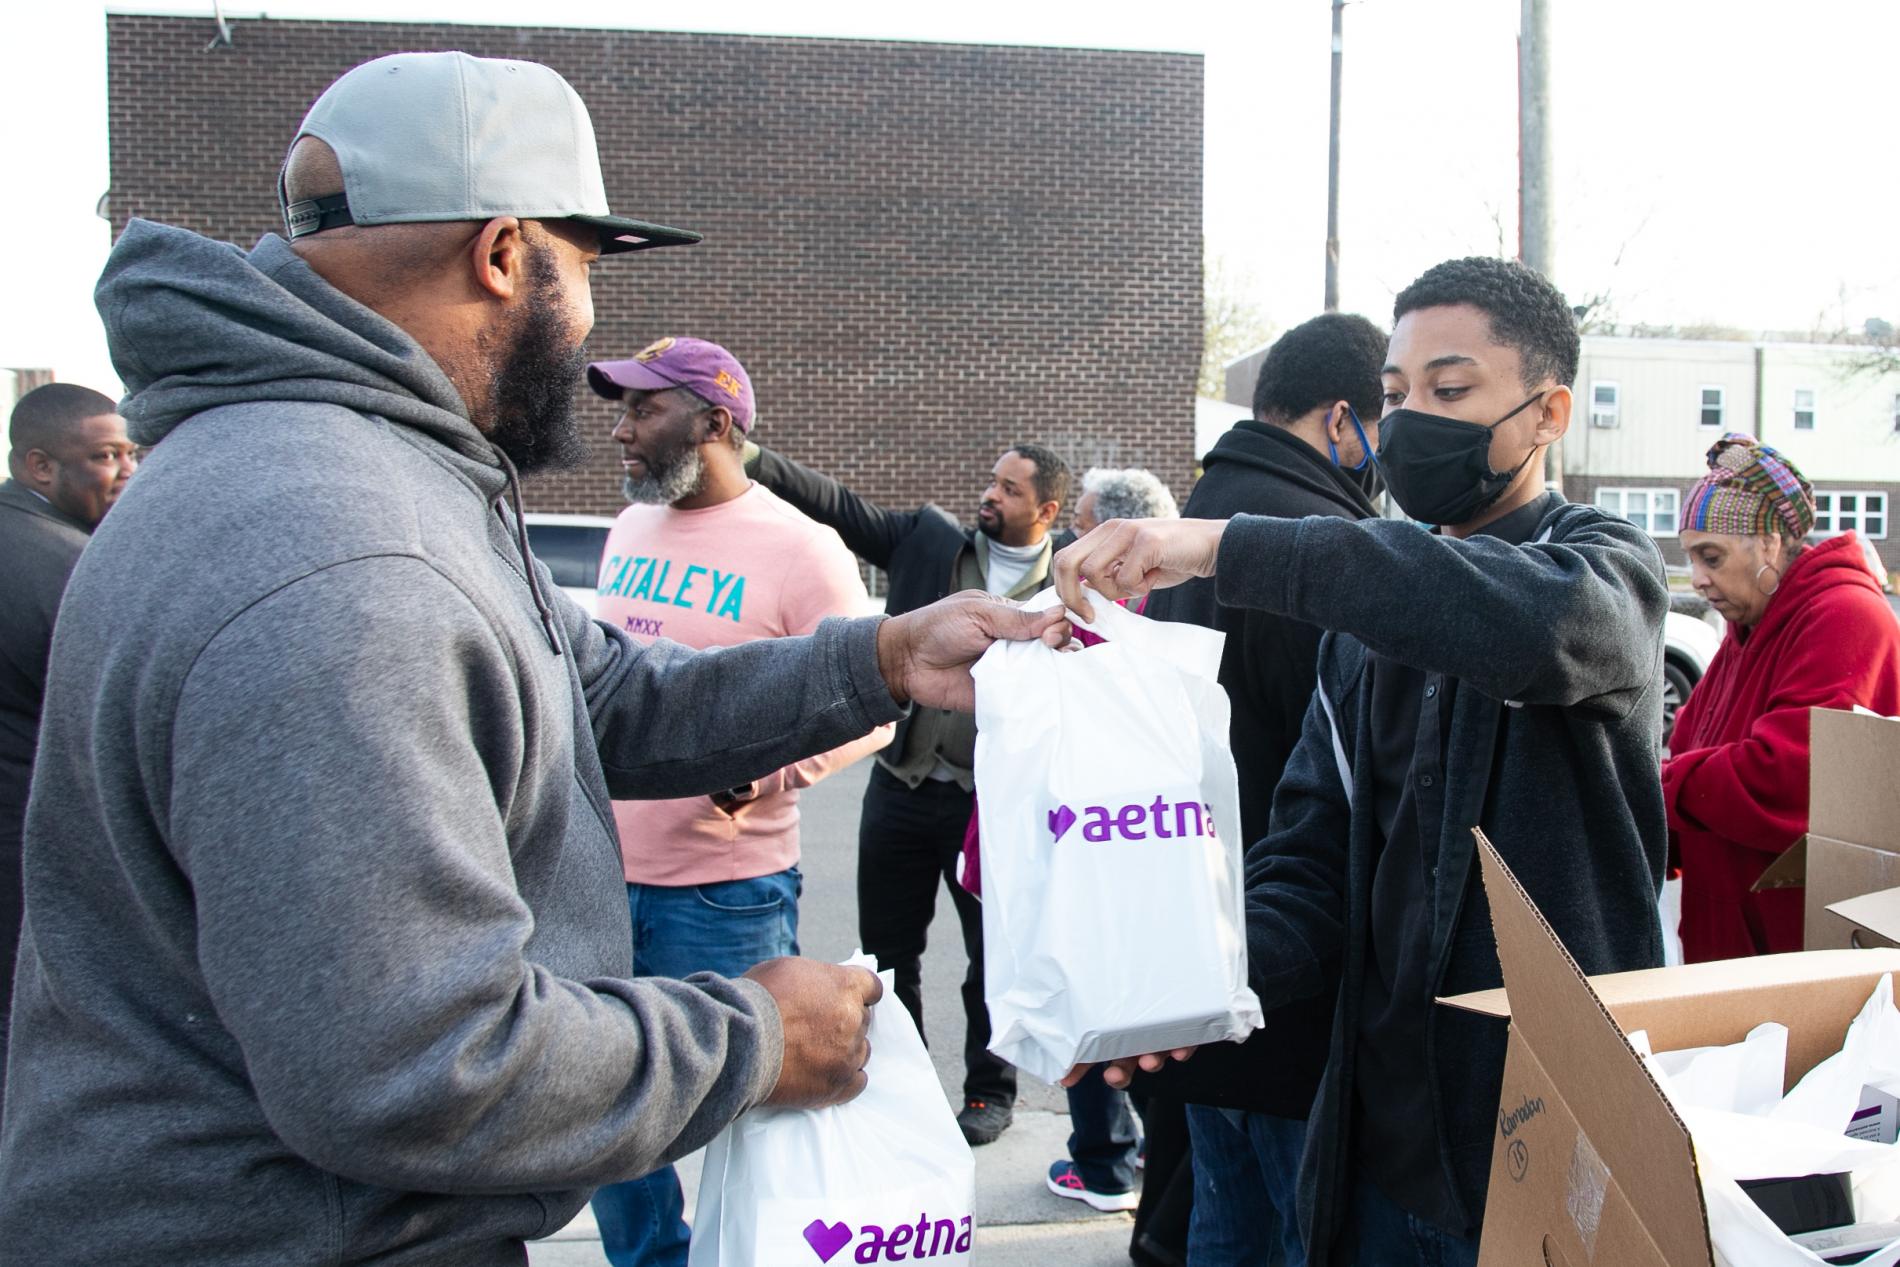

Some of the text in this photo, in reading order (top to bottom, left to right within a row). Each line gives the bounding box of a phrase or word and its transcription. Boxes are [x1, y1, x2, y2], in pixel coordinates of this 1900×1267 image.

[597, 554, 746, 623] CATALEYA
[624, 616, 664, 637] MMXX
[854, 1212, 972, 1265] aetna
